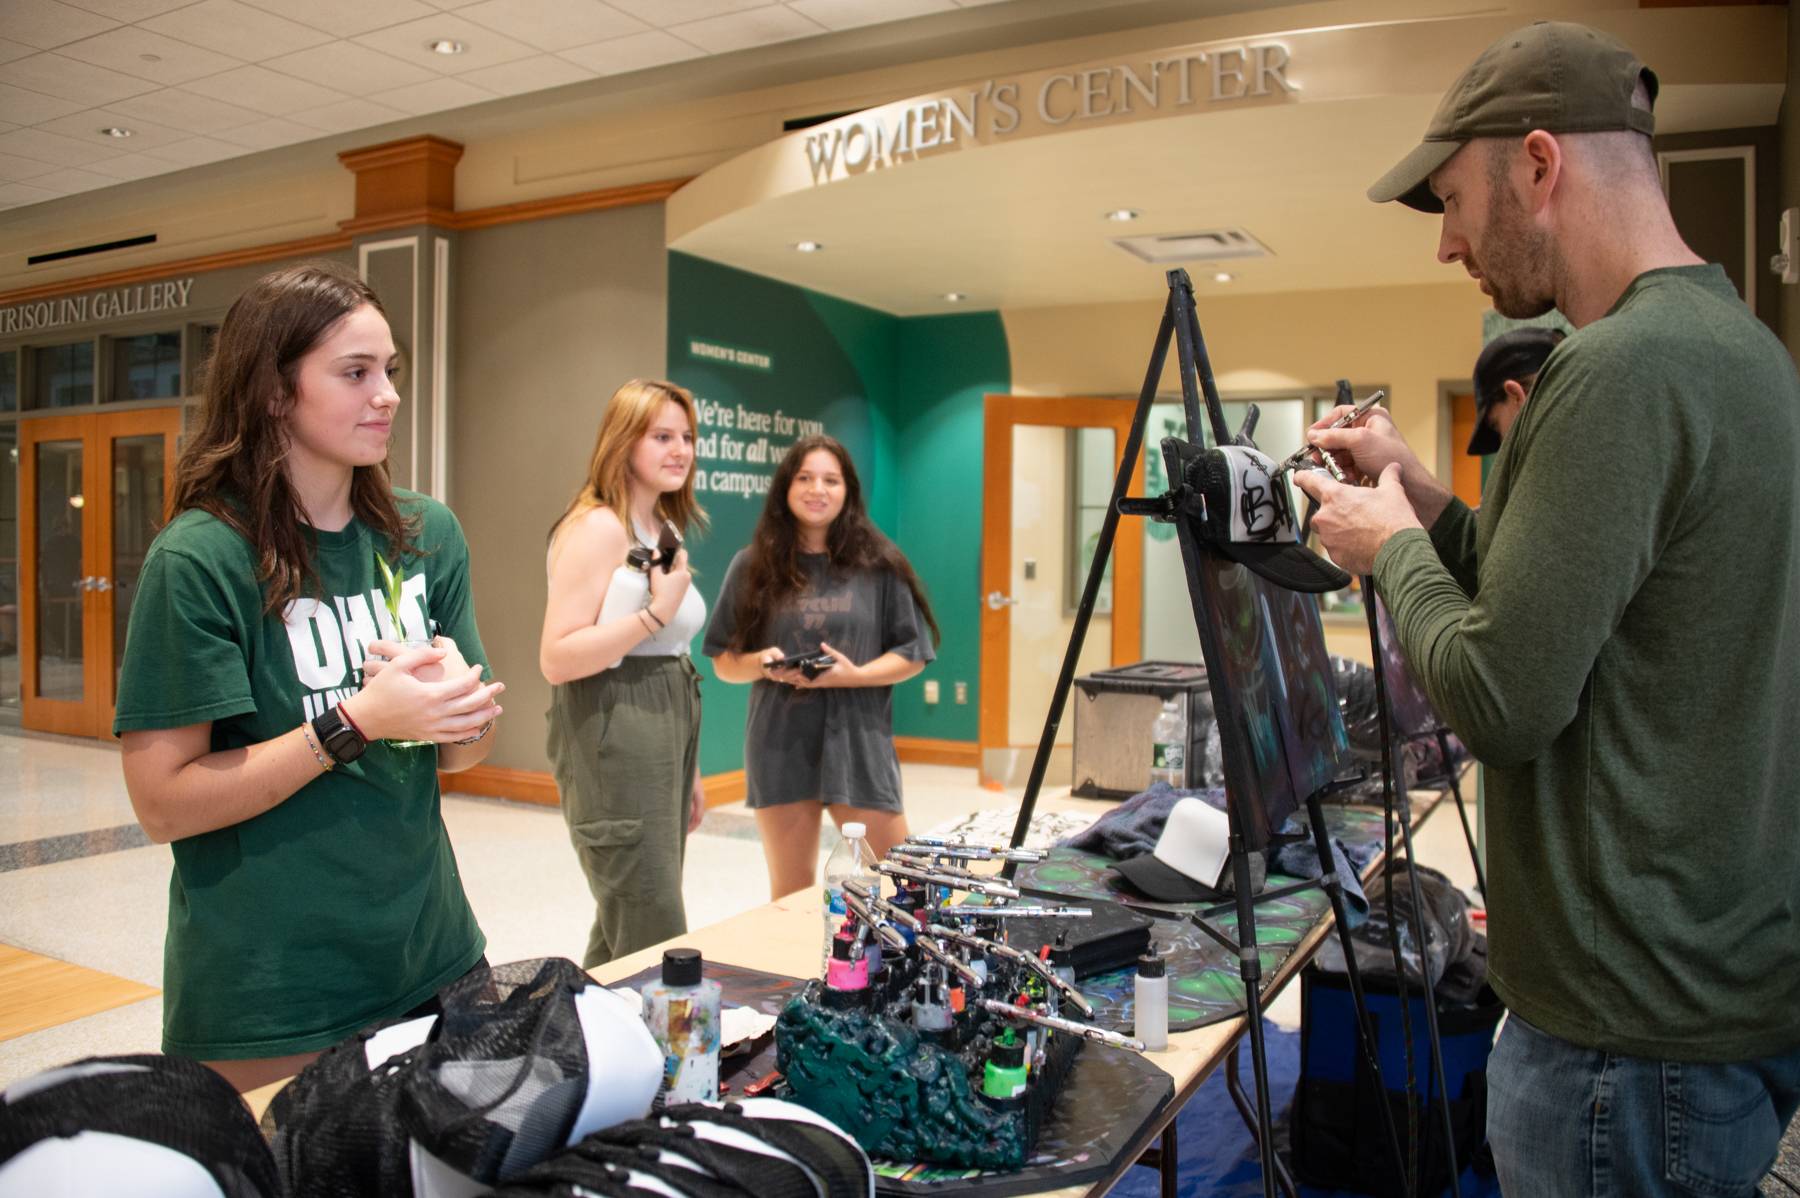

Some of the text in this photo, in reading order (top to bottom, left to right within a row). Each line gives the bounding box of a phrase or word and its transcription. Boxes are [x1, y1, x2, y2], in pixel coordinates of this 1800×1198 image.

[805, 41, 1304, 184] WOMEN'S CENTER
[92, 278, 194, 320] GALLERY
[691, 341, 770, 368] WOMEN'S CENTER
[737, 404, 772, 432] here
[774, 410, 795, 435] for
[695, 432, 717, 458] nd
[720, 433, 744, 460] for
[746, 438, 768, 463] all
[695, 469, 707, 490] n
